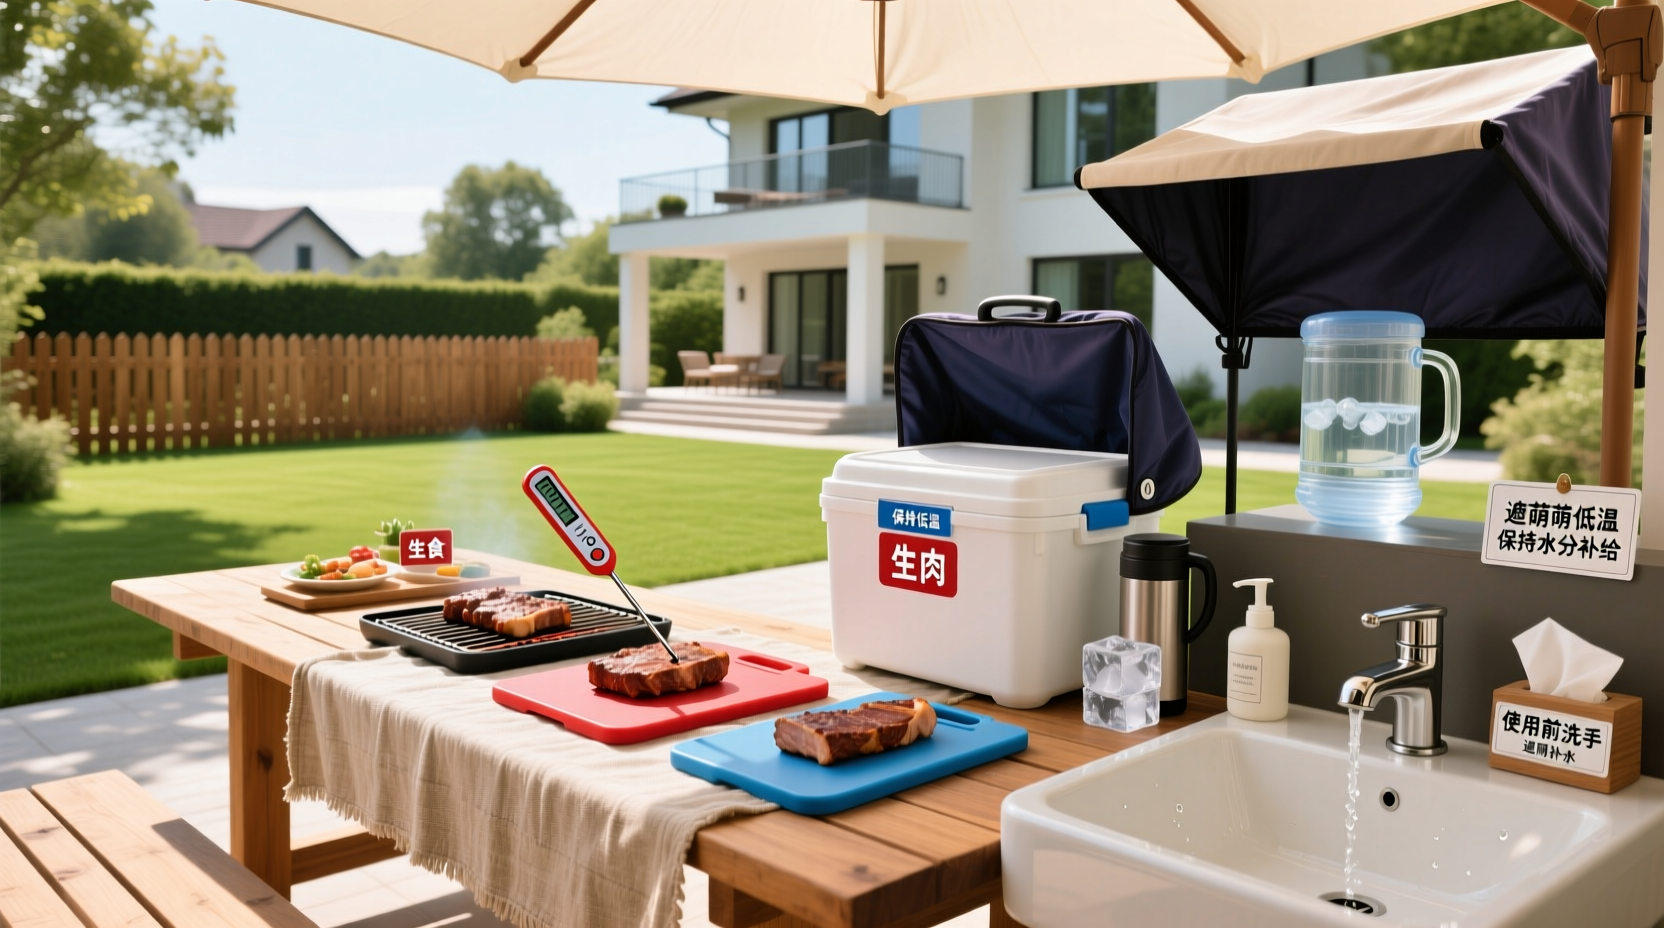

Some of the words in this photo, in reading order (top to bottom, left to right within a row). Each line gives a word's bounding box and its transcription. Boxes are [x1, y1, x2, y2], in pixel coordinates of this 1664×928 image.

[892, 508, 940, 530] 保持低温
[1497, 529, 1621, 561] 保持水分补给
[891, 543, 945, 587] 生肉
[1502, 709, 1602, 749] 使用前洗手
